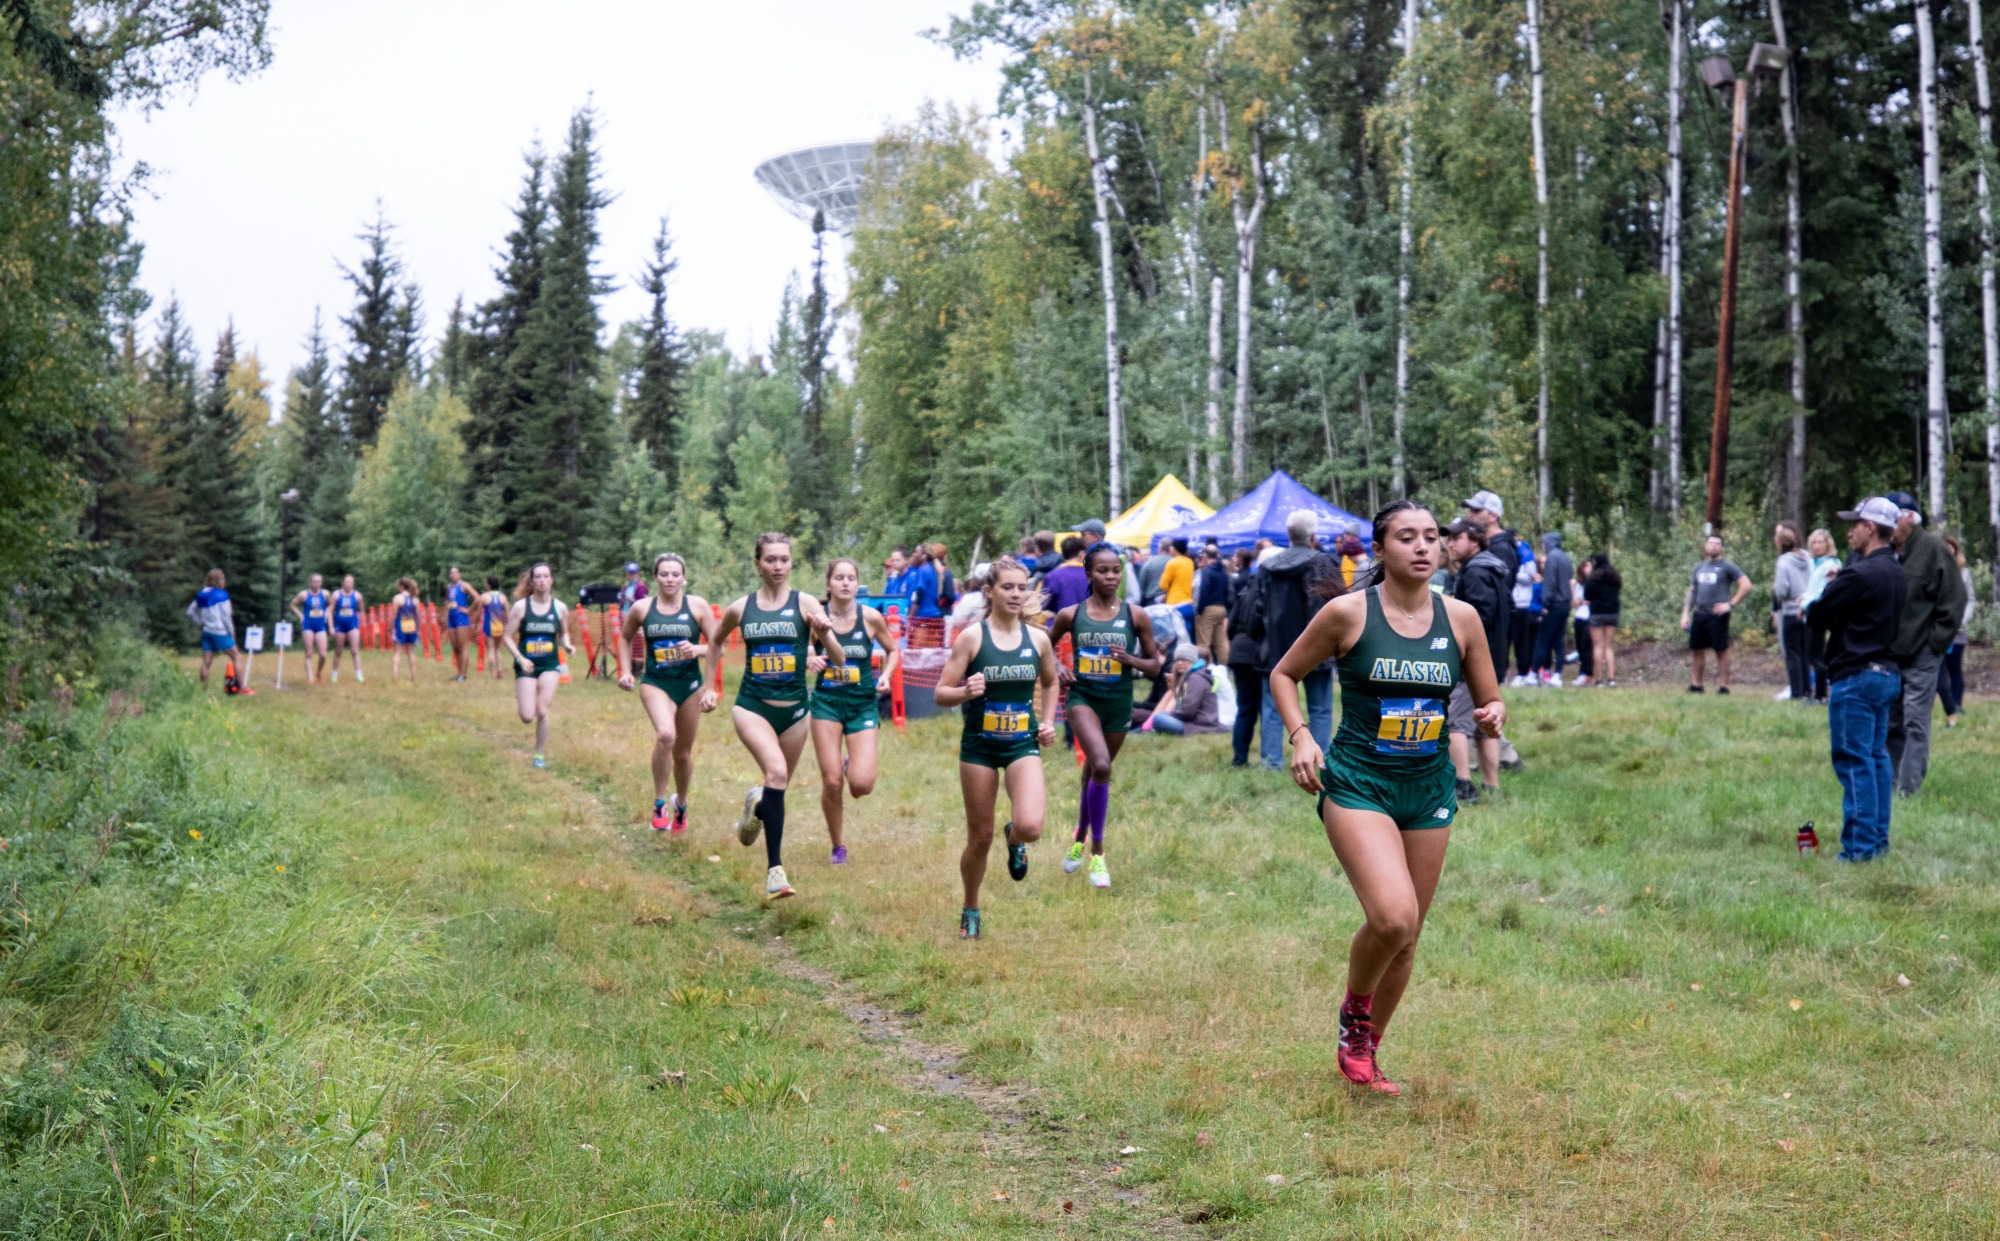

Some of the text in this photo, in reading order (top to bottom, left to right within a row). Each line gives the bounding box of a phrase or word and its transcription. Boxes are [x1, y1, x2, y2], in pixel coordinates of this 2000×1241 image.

[646, 623, 692, 637] ALASKA
[743, 621, 798, 639] ALASKA
[1077, 632, 1127, 649] ALASKA
[762, 657, 784, 673] 113
[983, 664, 1037, 681] ALASKA
[1089, 659, 1111, 674] 114
[1369, 657, 1452, 686] ALASKA
[995, 715, 1018, 731] 115
[1397, 718, 1431, 741] 117
